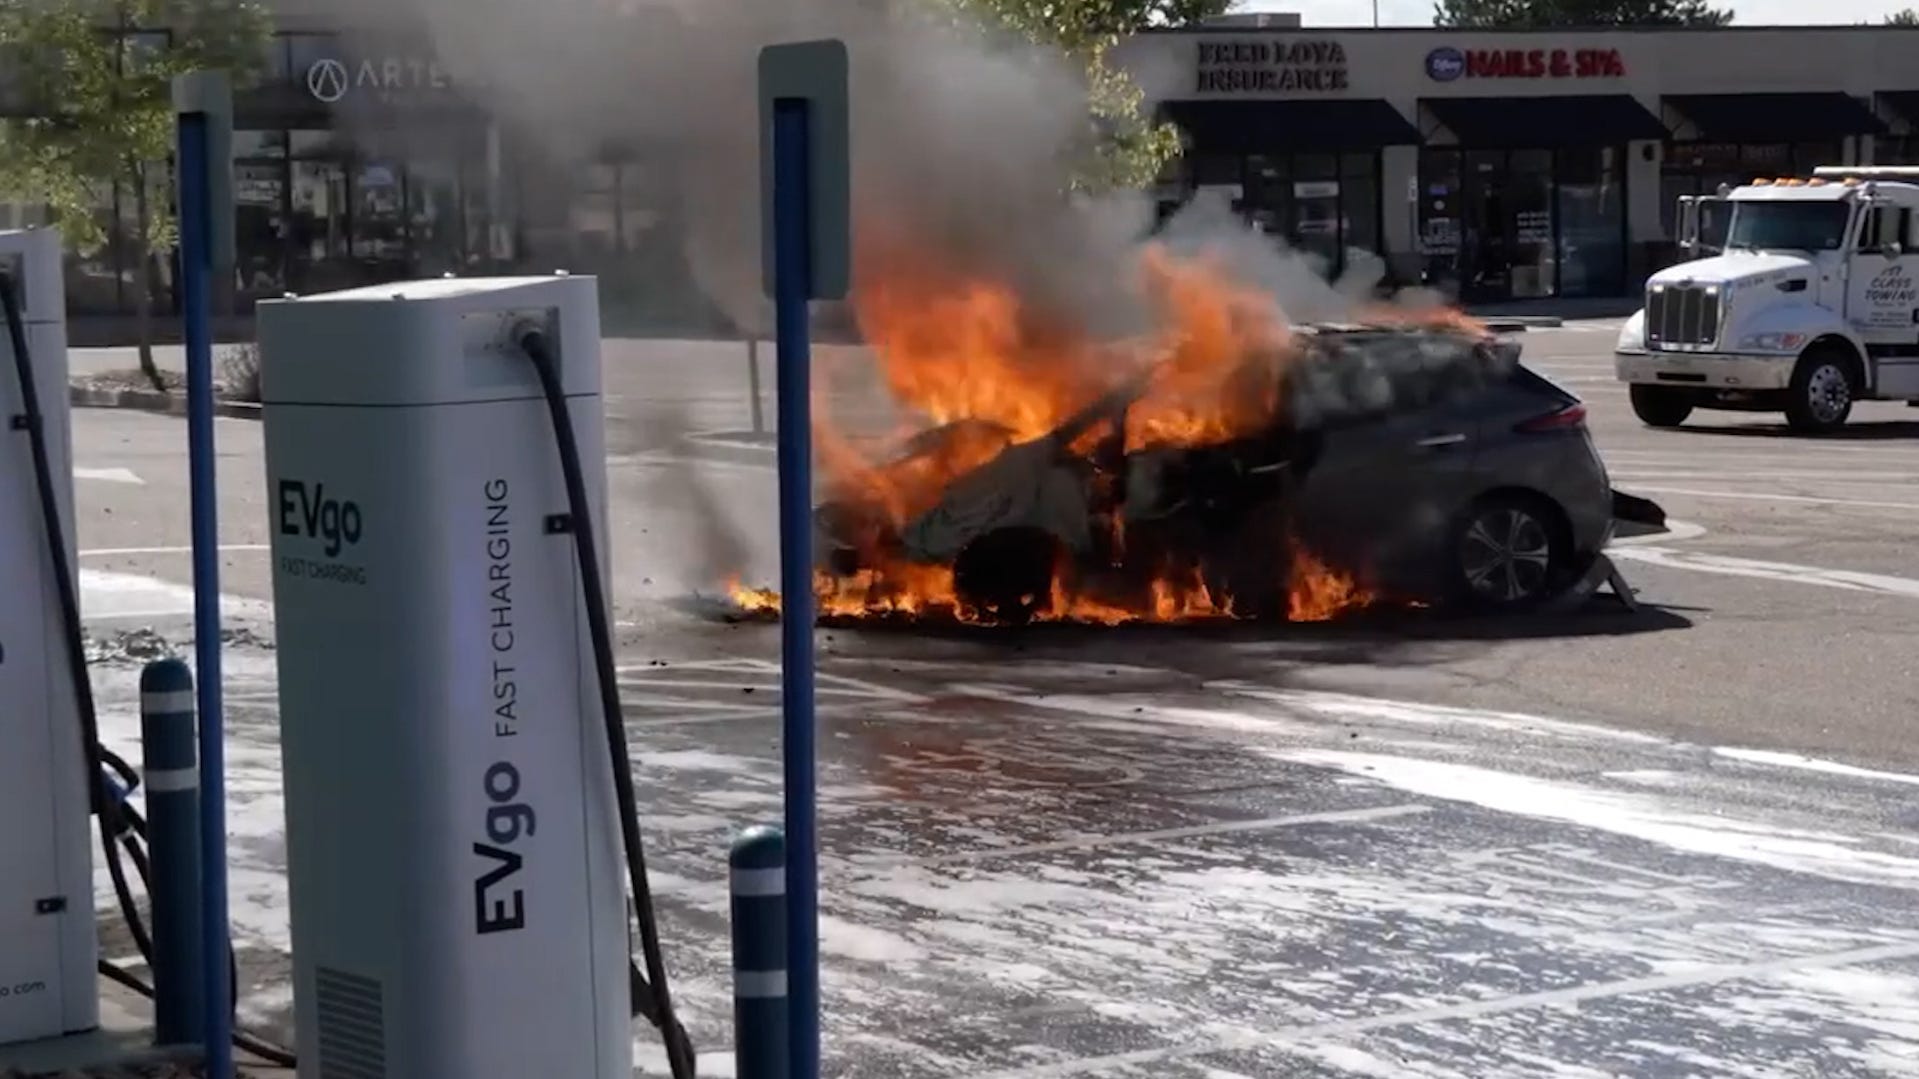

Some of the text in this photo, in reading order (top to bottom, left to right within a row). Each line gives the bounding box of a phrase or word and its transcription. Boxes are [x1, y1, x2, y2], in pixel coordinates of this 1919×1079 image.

[1465, 49, 1545, 78] NAILS
[1549, 49, 1571, 77] &
[1575, 48, 1625, 77] SPA
[1197, 68, 1349, 92] INSURANCE
[1865, 289, 1917, 301] TOWING
[279, 479, 362, 558] EVgo
[473, 478, 537, 935] EVgo FAST CHARGING
